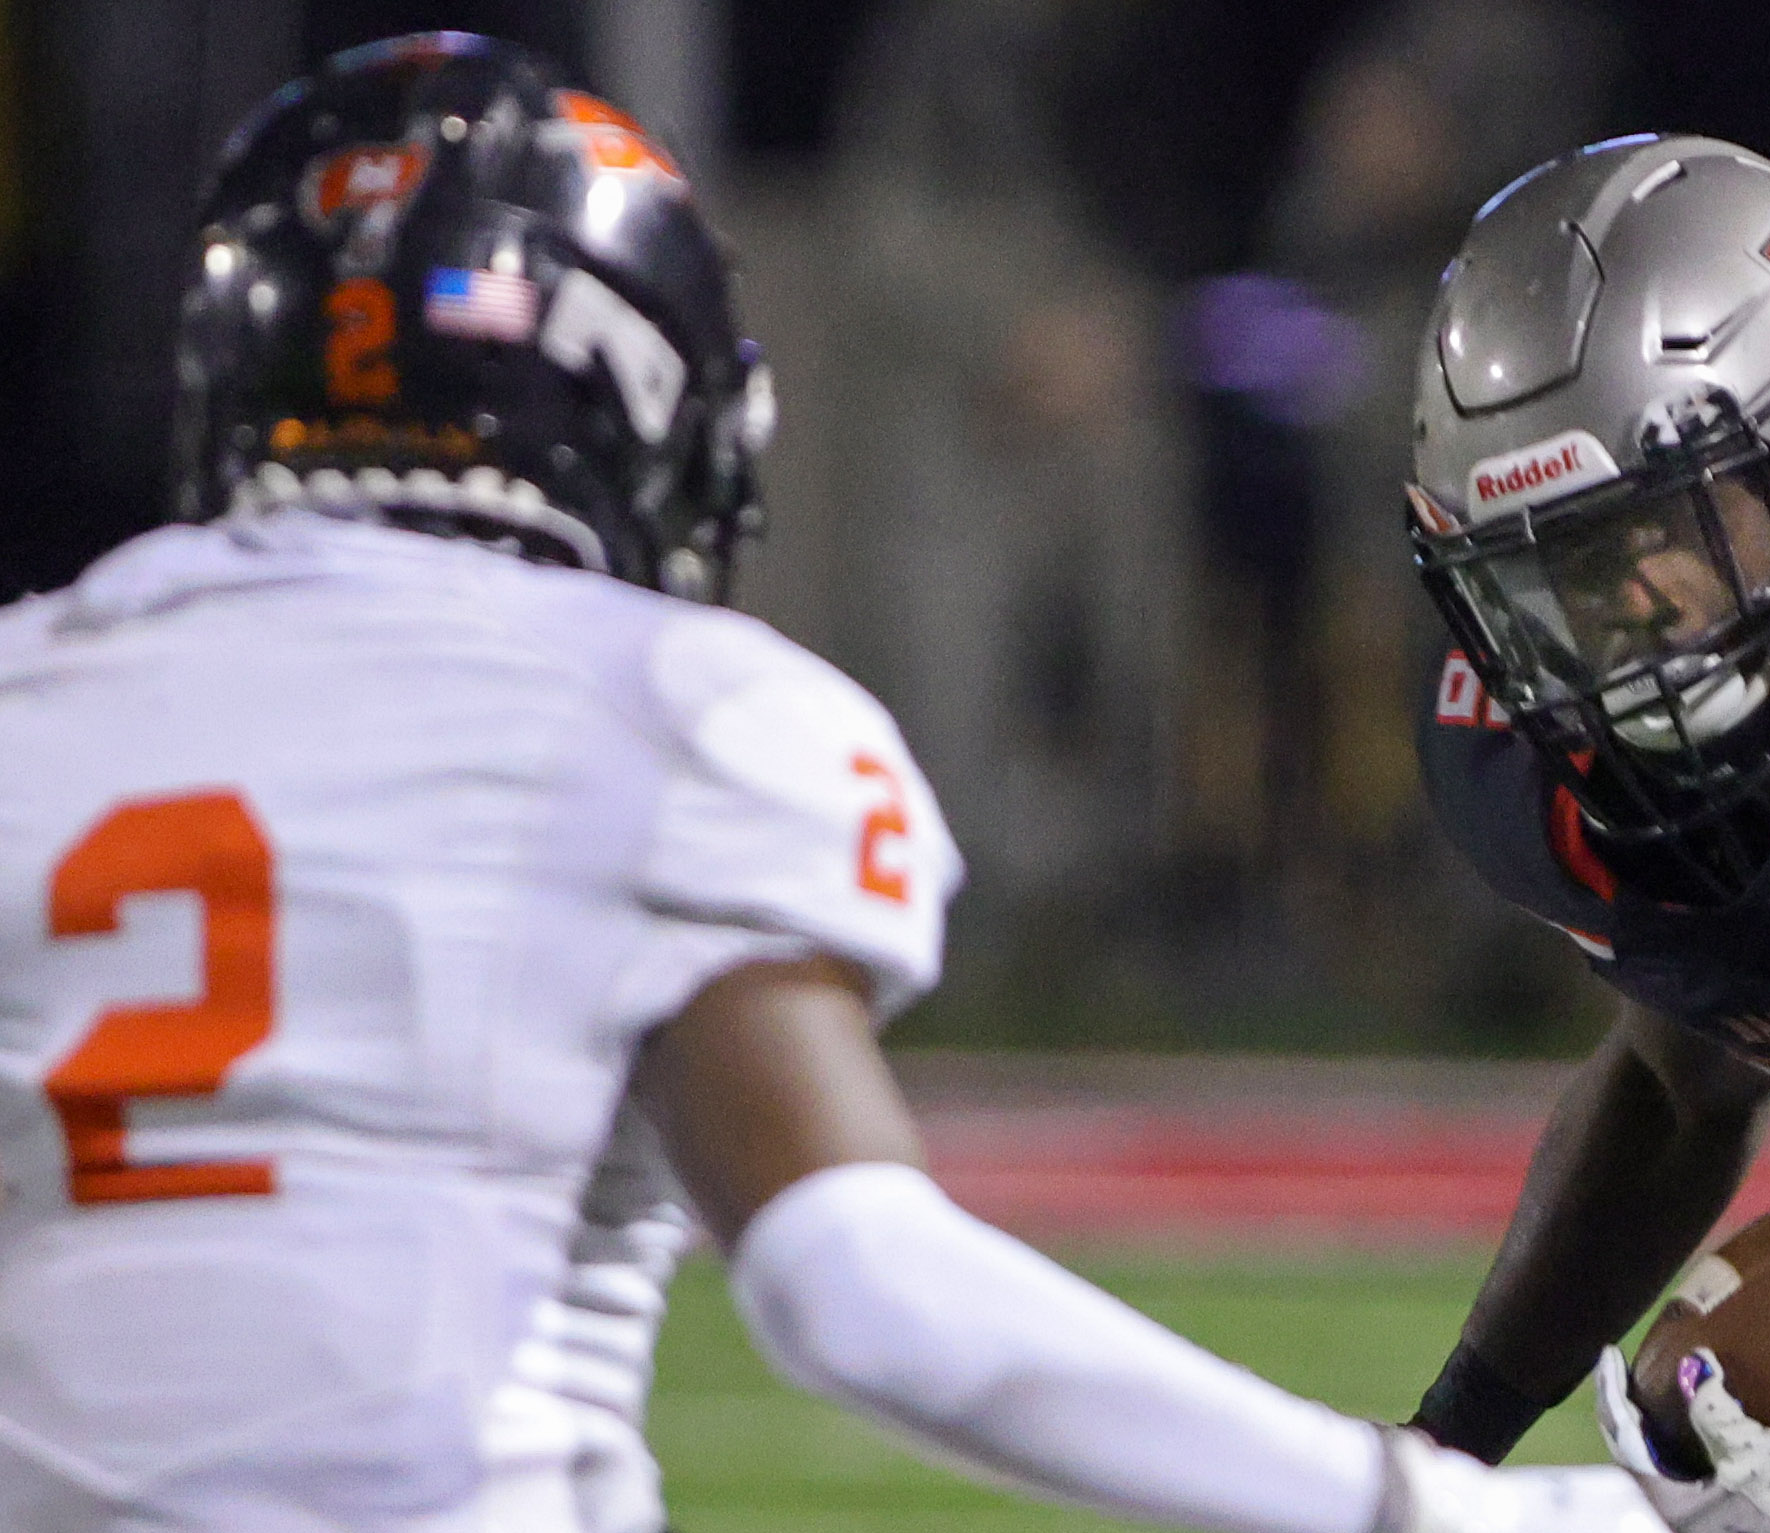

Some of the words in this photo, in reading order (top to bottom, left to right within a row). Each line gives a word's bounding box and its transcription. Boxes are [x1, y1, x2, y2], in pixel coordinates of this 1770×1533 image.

[324, 277, 398, 402] 2
[1476, 441, 1582, 502] Riddell
[852, 756, 909, 903] 2
[44, 784, 277, 1206] 2
